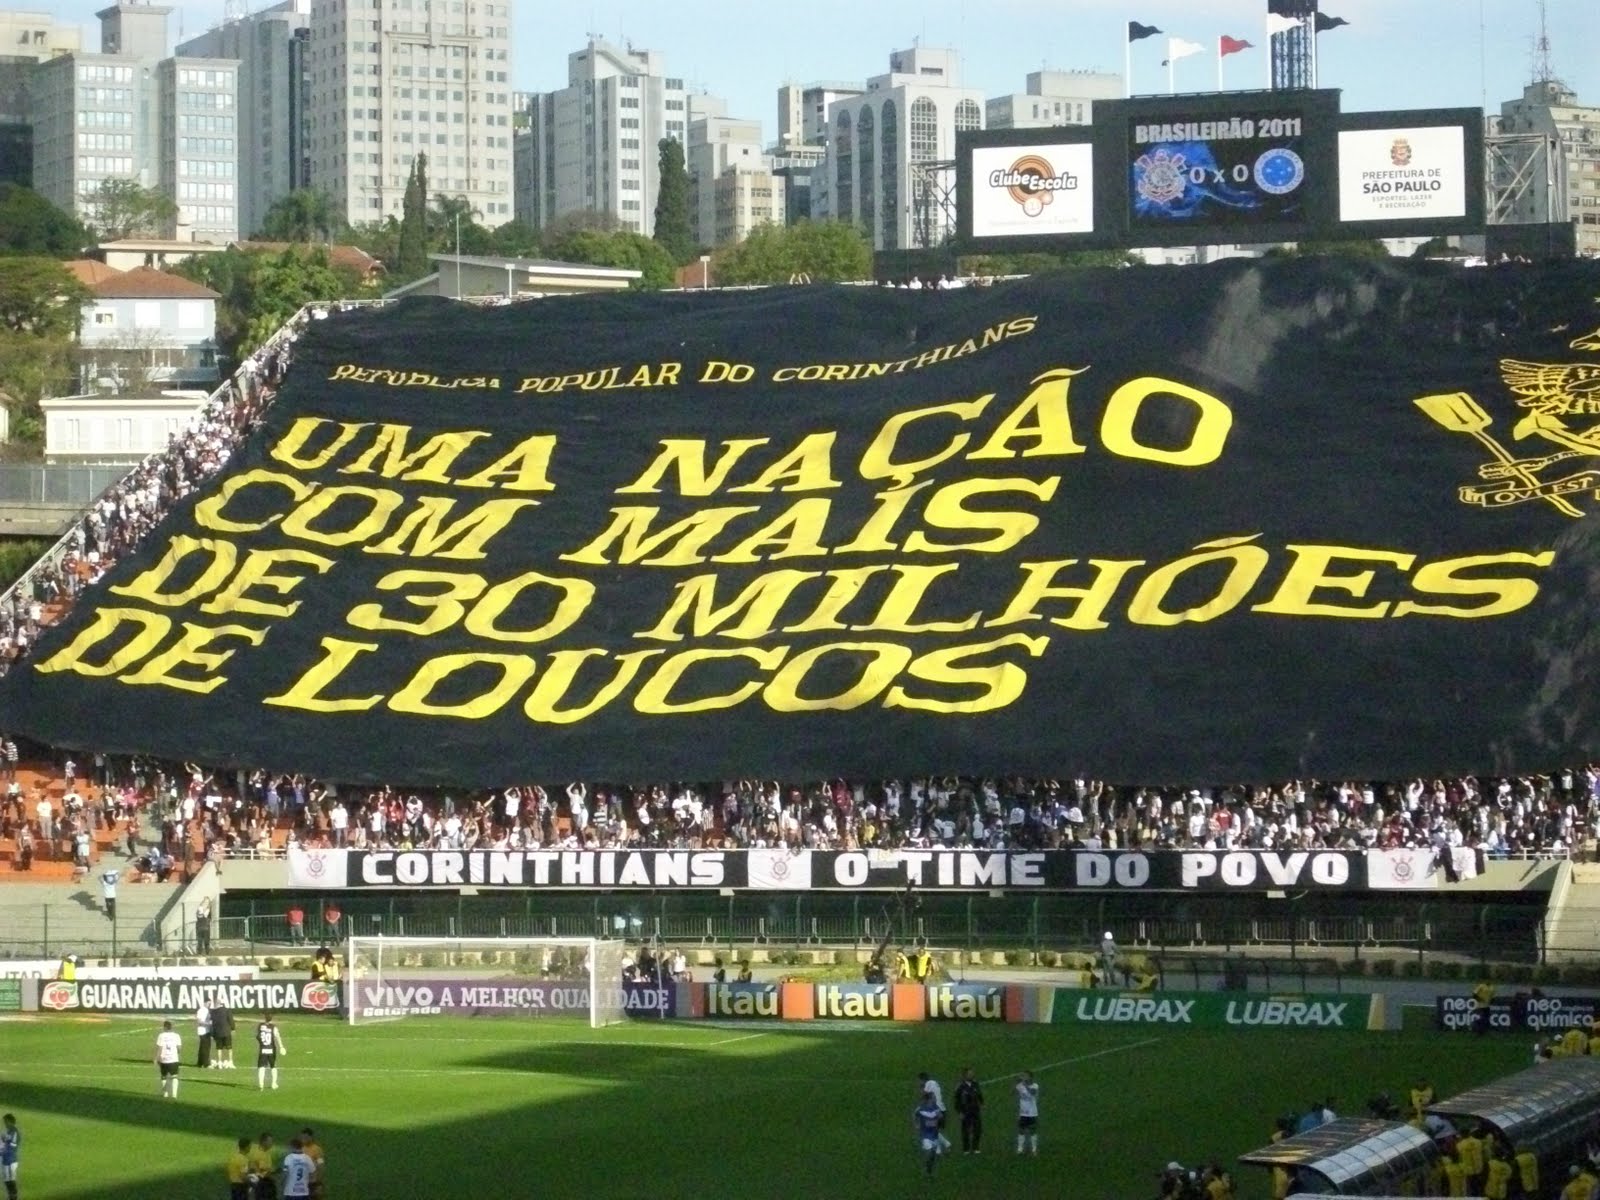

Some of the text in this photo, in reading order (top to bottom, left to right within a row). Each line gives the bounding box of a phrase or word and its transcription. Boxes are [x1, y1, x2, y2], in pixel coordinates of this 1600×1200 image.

[1135, 117, 1302, 144] BRASILEIRÃO 2011
[1362, 168, 1441, 180] PREFEITURA DE
[1363, 180, 1441, 194] SÃO PAULO
[513, 362, 682, 393] POPULAR
[698, 361, 756, 383] DO
[772, 316, 1038, 382] CORINTHIANS
[270, 365, 1235, 497] UMA NAÇÃO
[1551, 476, 1594, 493] EST
[194, 468, 1062, 566] COM MAIS
[108, 532, 1556, 643] DE 30 MILHÕES
[34, 606, 1052, 724] DE LOUCOS
[361, 851, 1350, 887] CORINTHIANS O TIME DO POVO
[81, 981, 299, 1010] GUARANÁ ANTARCTICA
[364, 986, 670, 1010] VIVO A MELHOR QUALIDADE
[708, 983, 778, 1016] Itaú
[818, 984, 889, 1016] Itaú
[929, 986, 1001, 1018] Itaú
[1077, 997, 1196, 1023] LUBRAX
[1443, 998, 1478, 1011] neo
[1527, 998, 1562, 1012] neo
[1225, 1000, 1348, 1026] LUBRAX
